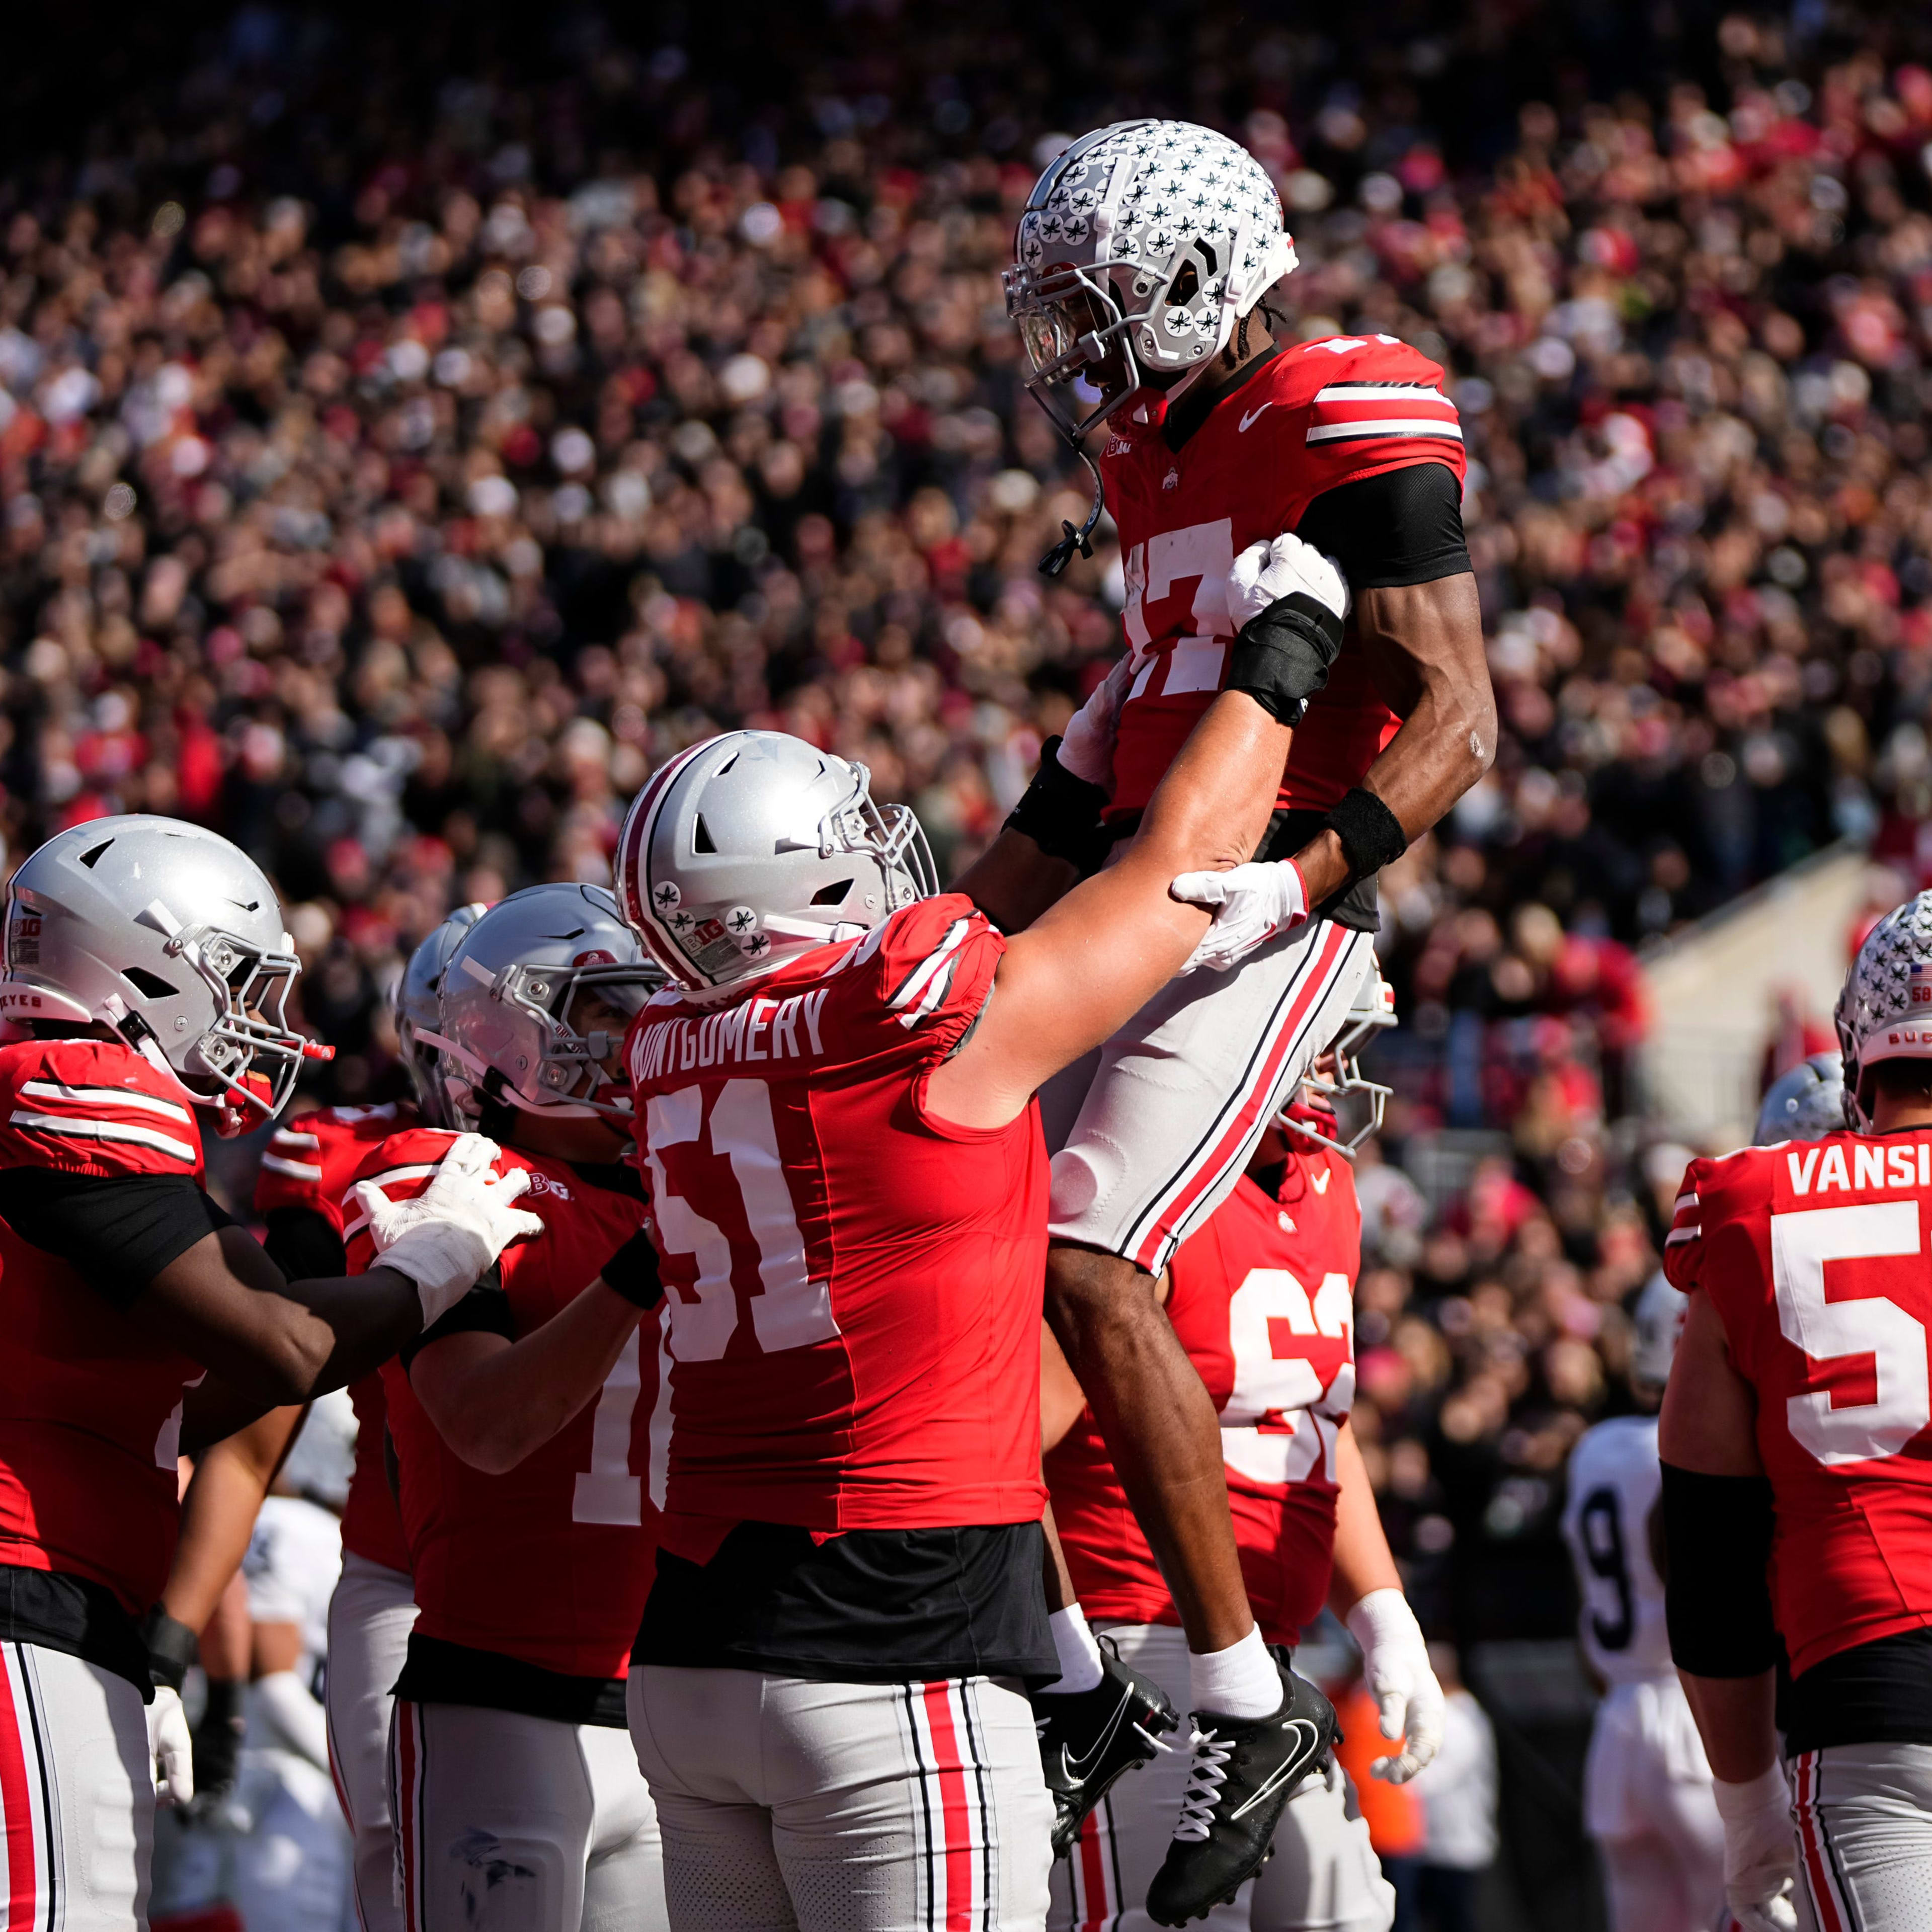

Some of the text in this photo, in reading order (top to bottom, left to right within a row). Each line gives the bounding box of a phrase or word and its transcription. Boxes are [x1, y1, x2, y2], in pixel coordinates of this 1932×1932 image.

[1120, 517, 1236, 702] 17
[630, 988, 830, 1091] MONTGOMERY
[1912, 986, 1931, 1002] 58
[645, 1078, 841, 1362] 51
[1787, 1144, 1930, 1196] VANSI
[1770, 1200, 1932, 1467] 5
